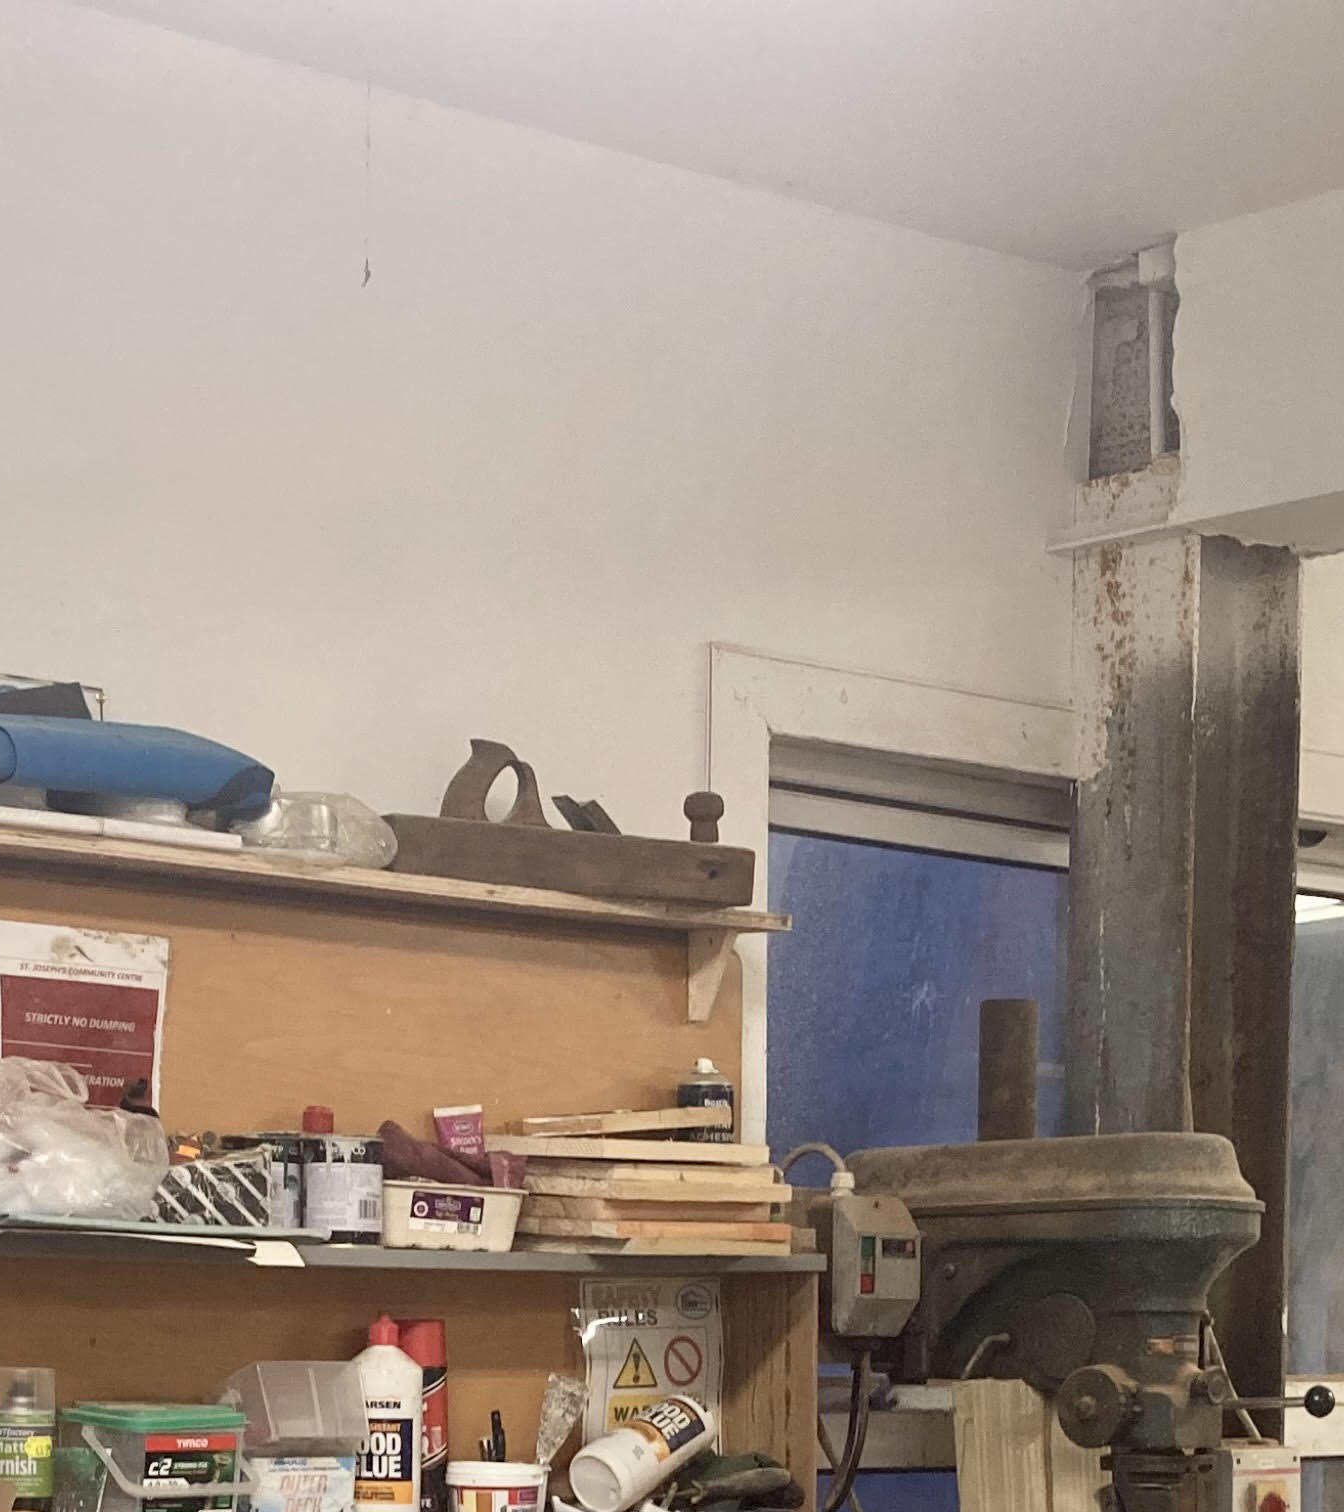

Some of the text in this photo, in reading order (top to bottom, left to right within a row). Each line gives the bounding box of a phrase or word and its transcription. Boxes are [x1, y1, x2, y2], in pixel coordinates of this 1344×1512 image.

[68, 967, 116, 979] COMMUNITY
[117, 973, 143, 982] CENTRE
[24, 1011, 136, 1032] STRICTLY NO DUMPING
[357, 1431, 402, 1455] OOD
